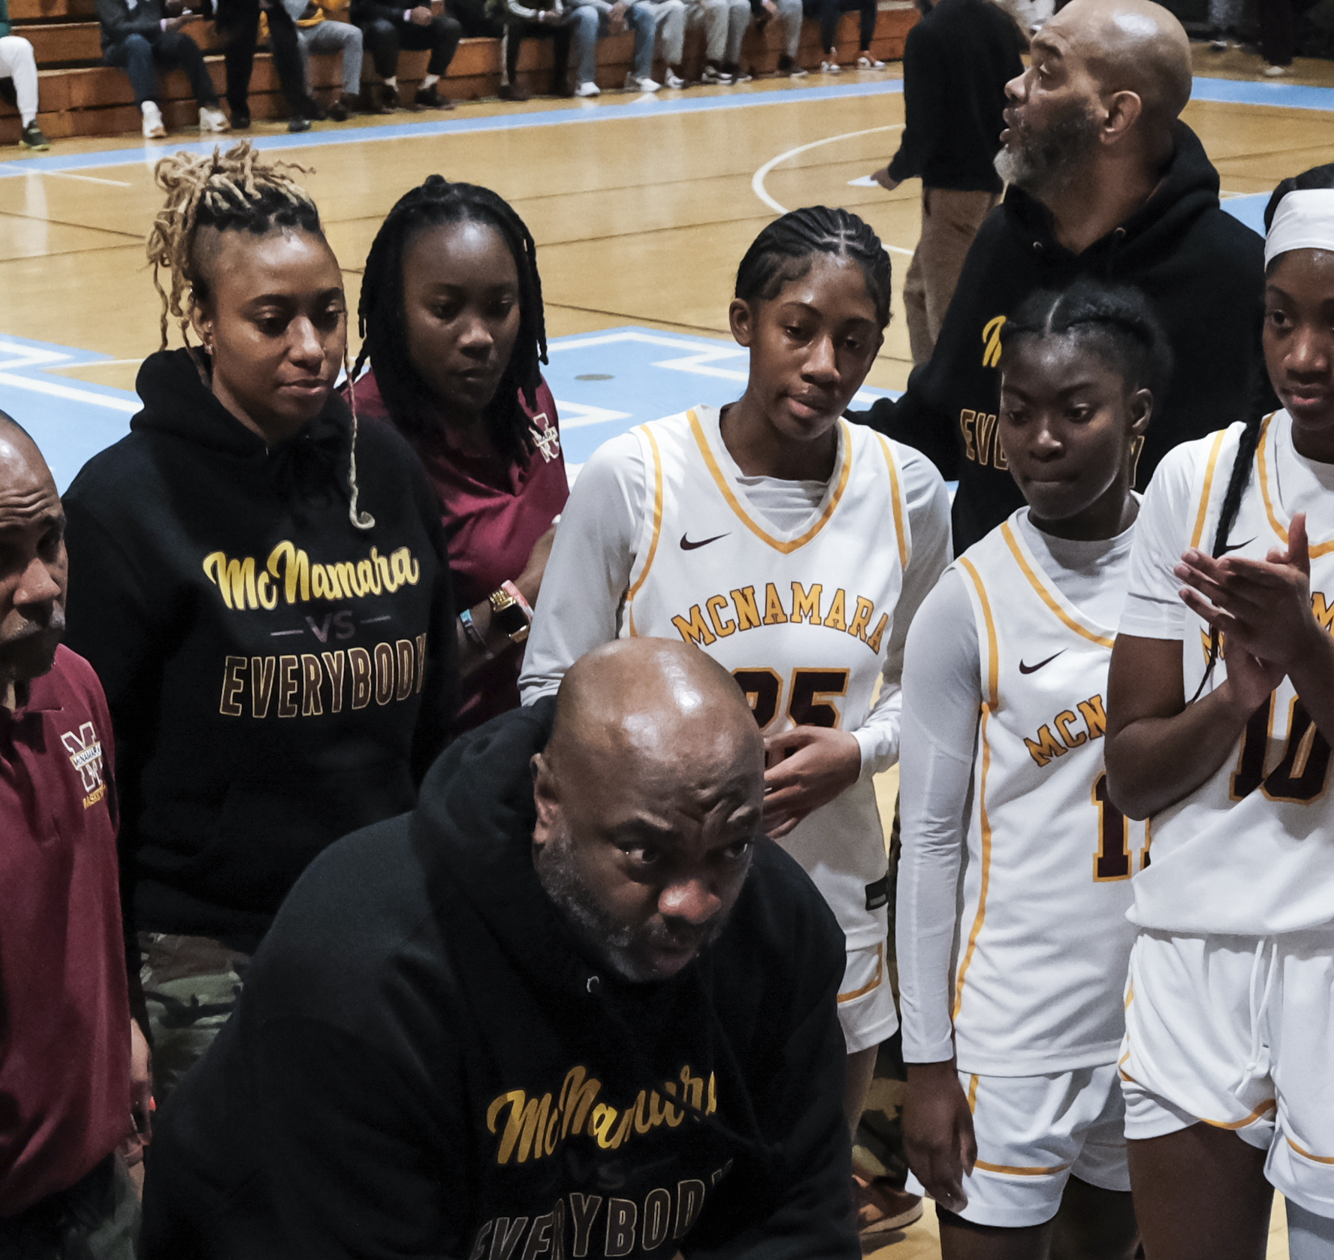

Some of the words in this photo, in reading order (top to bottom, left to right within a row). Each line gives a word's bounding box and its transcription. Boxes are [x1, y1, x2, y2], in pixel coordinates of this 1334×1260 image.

[202, 539, 420, 611] McNamara
[305, 610, 356, 643] VS
[671, 581, 889, 655] MCNAMARA
[1090, 770, 1153, 883] 1
